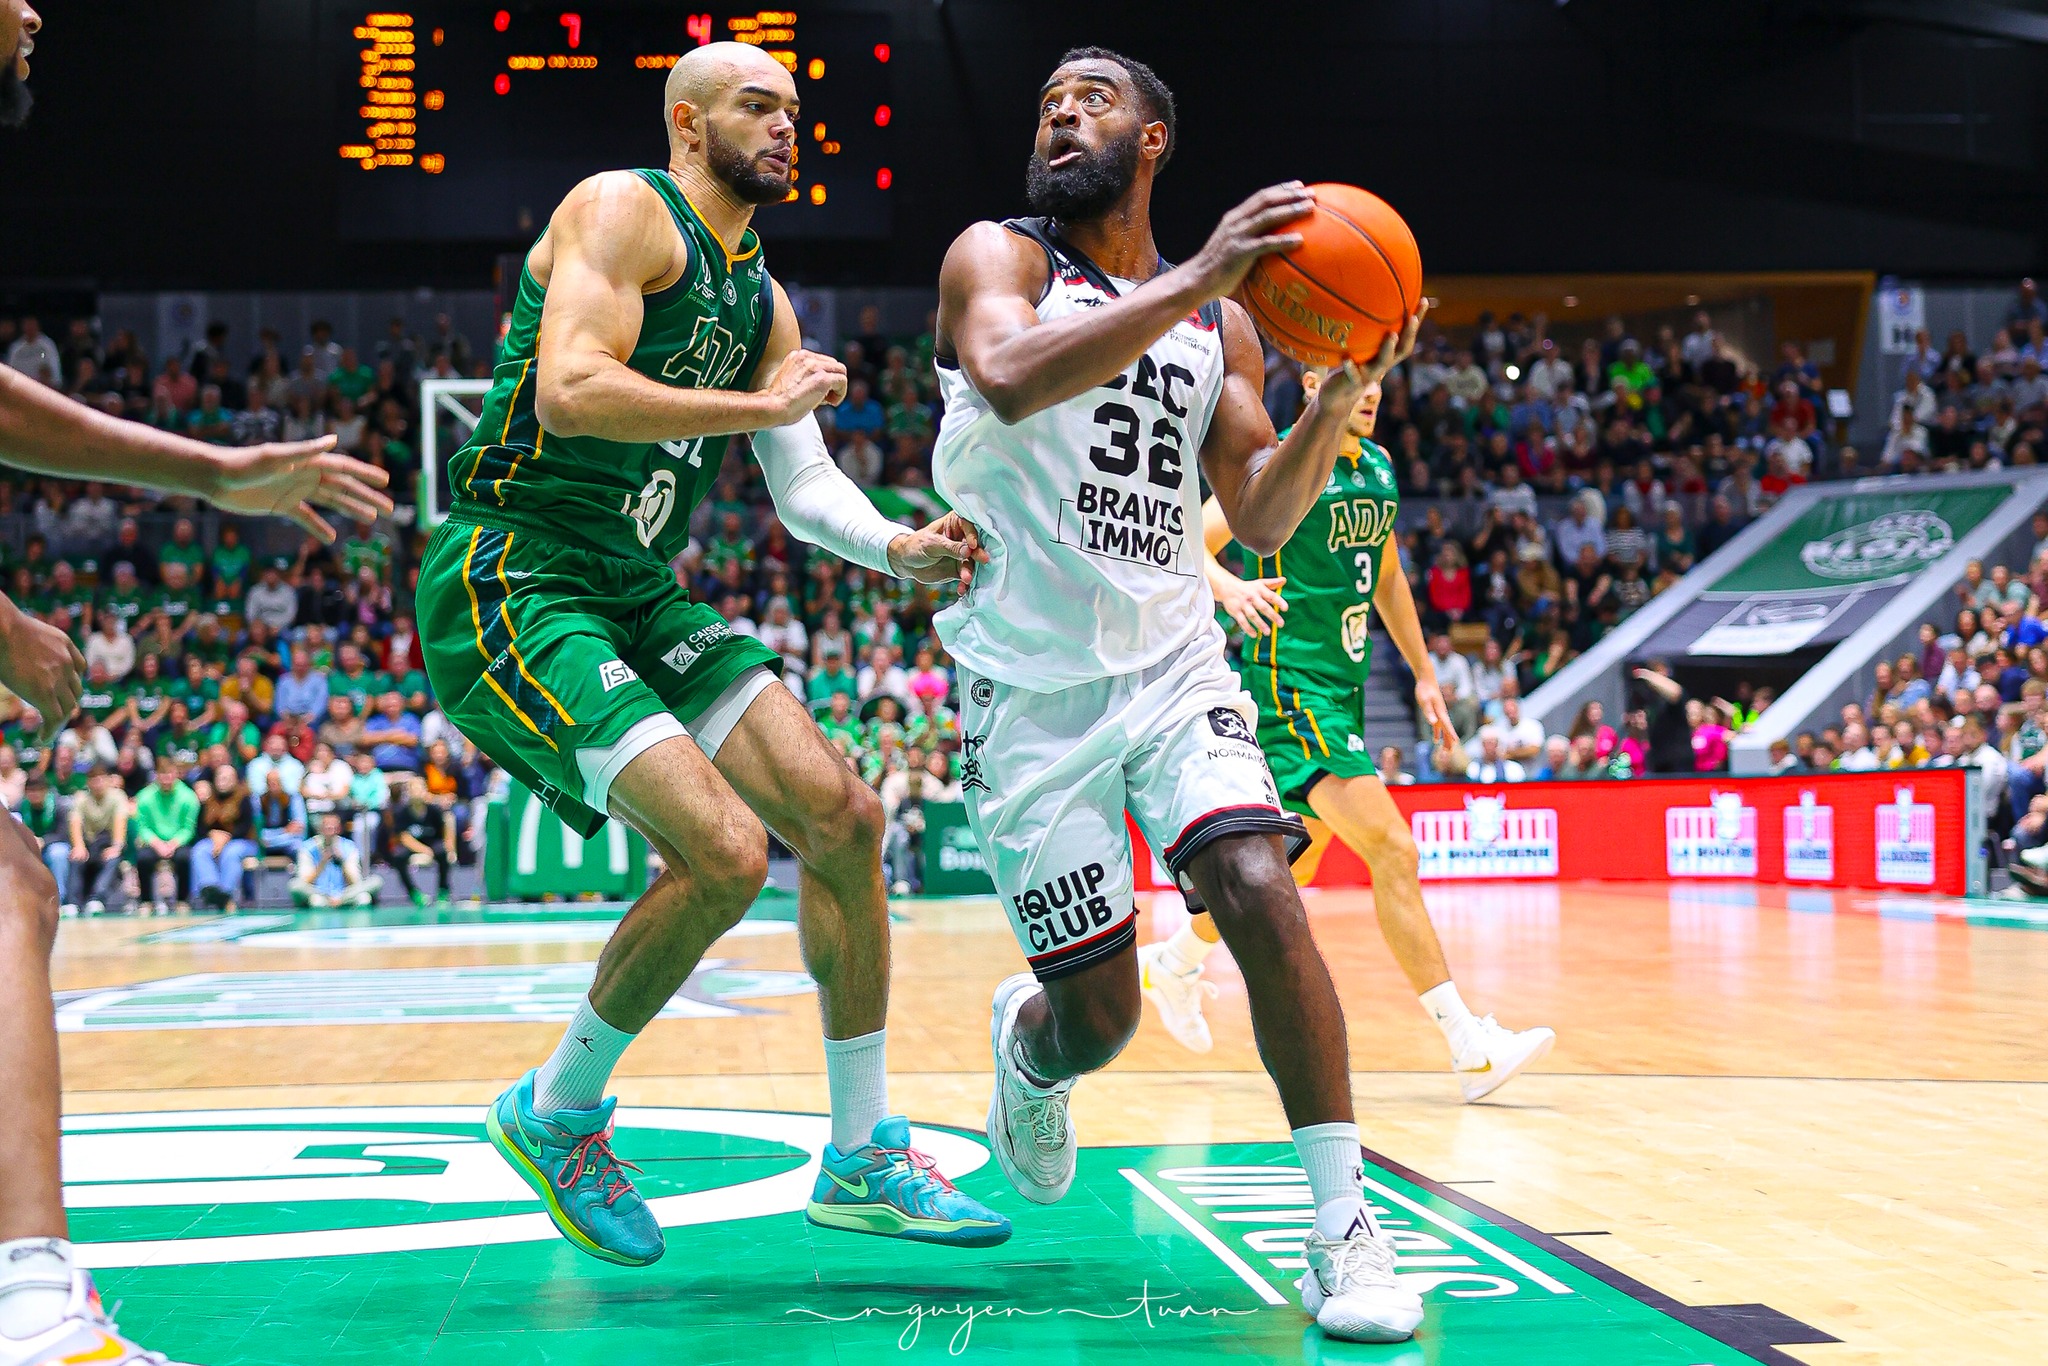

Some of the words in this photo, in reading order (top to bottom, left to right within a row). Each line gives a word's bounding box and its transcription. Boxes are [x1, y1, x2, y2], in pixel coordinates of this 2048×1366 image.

[1089, 401, 1184, 491] 32
[1076, 482, 1184, 535] BRAVIS
[1087, 519, 1172, 566] IMMO
[1354, 552, 1372, 594] 3
[688, 621, 726, 644] CAISSE
[1013, 862, 1105, 924] EQUIP
[1028, 895, 1113, 953] CLUB
